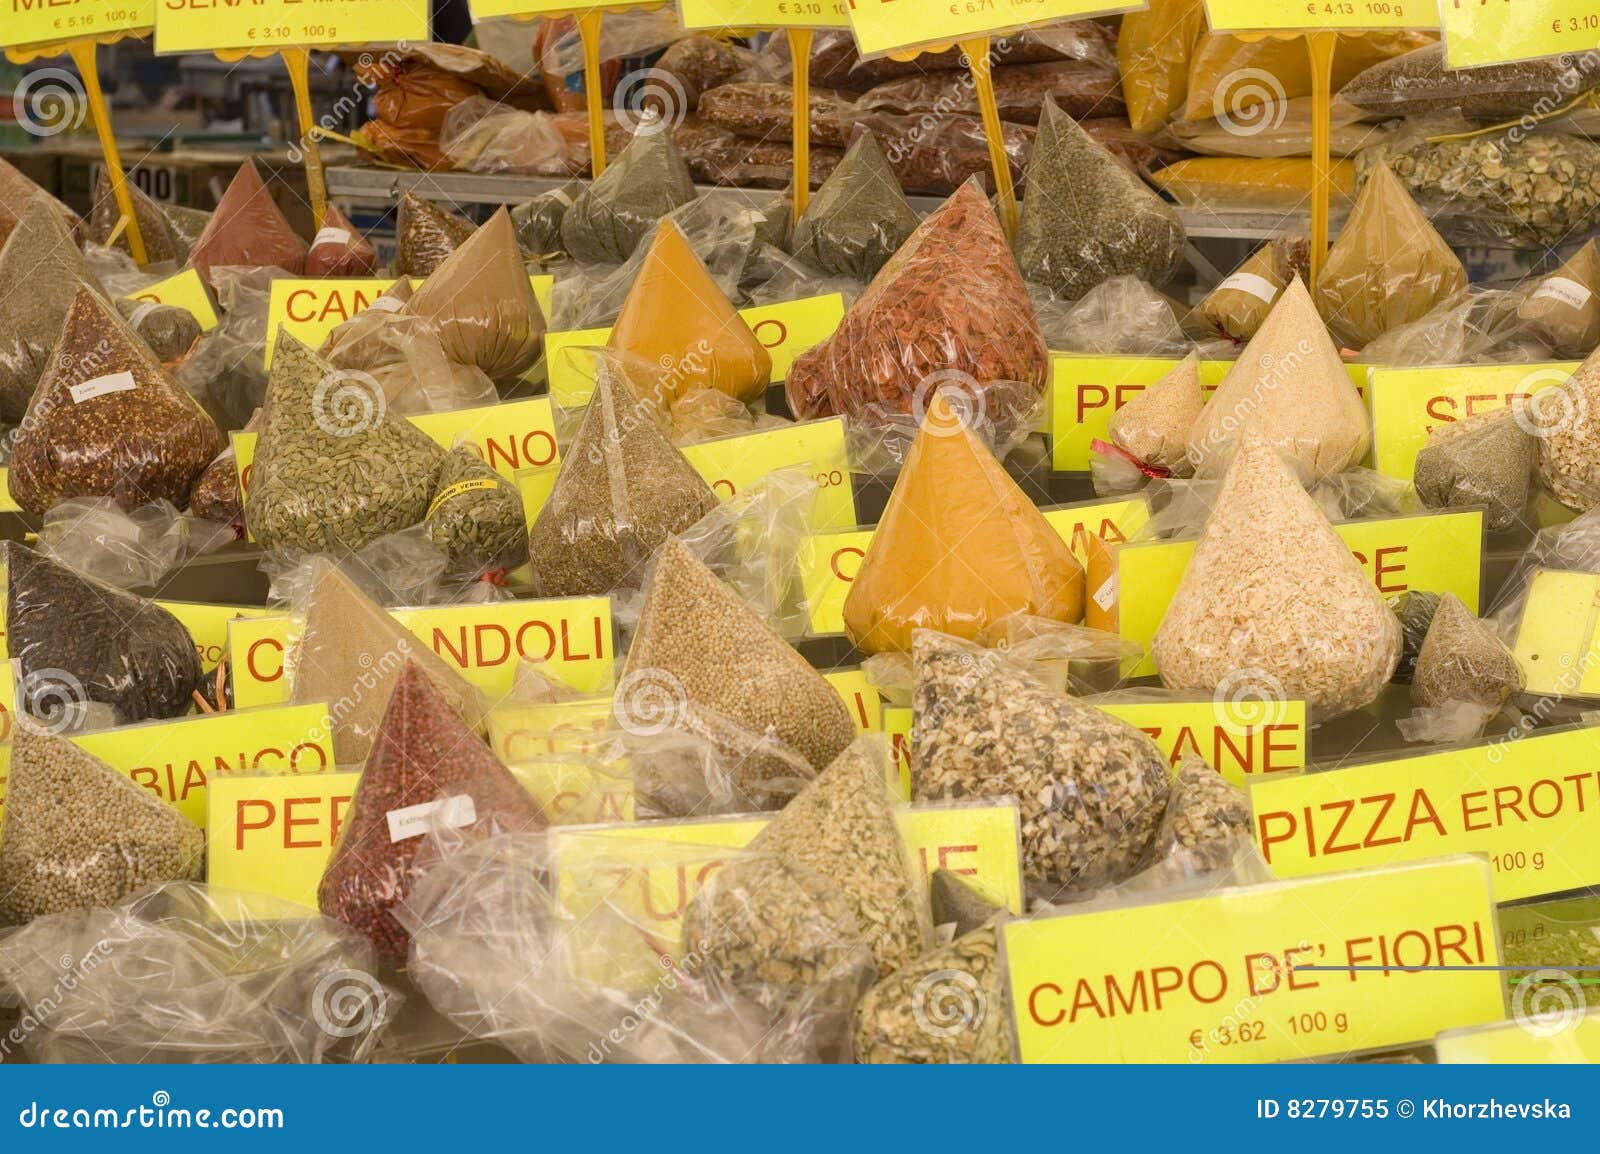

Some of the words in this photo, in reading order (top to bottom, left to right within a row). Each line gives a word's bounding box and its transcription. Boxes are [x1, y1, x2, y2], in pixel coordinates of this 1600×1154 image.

[794, 3, 821, 15] 3.10
[966, 0, 994, 14] 6.71
[1324, 3, 1354, 15] 4.13
[1366, 3, 1391, 15] 100
[1394, 5, 1404, 17] g
[67, 14, 94, 27] 5.16
[105, 10, 126, 21] 100
[129, 10, 138, 21] g
[1569, 15, 1599, 32] 3.10
[263, 26, 290, 39] 3.10
[303, 25, 325, 37] 100
[328, 26, 337, 38] g
[1258, 788, 1448, 865] PIZZA
[1491, 850, 1527, 873] 100
[1532, 850, 1545, 869] g
[1028, 960, 1228, 1027] CAMPO
[1346, 921, 1485, 982] FIORI
[1189, 1028, 1204, 1049] €
[1217, 1020, 1267, 1046] 3.62
[1287, 1011, 1328, 1036] 100
[1335, 1011, 1349, 1034] g
